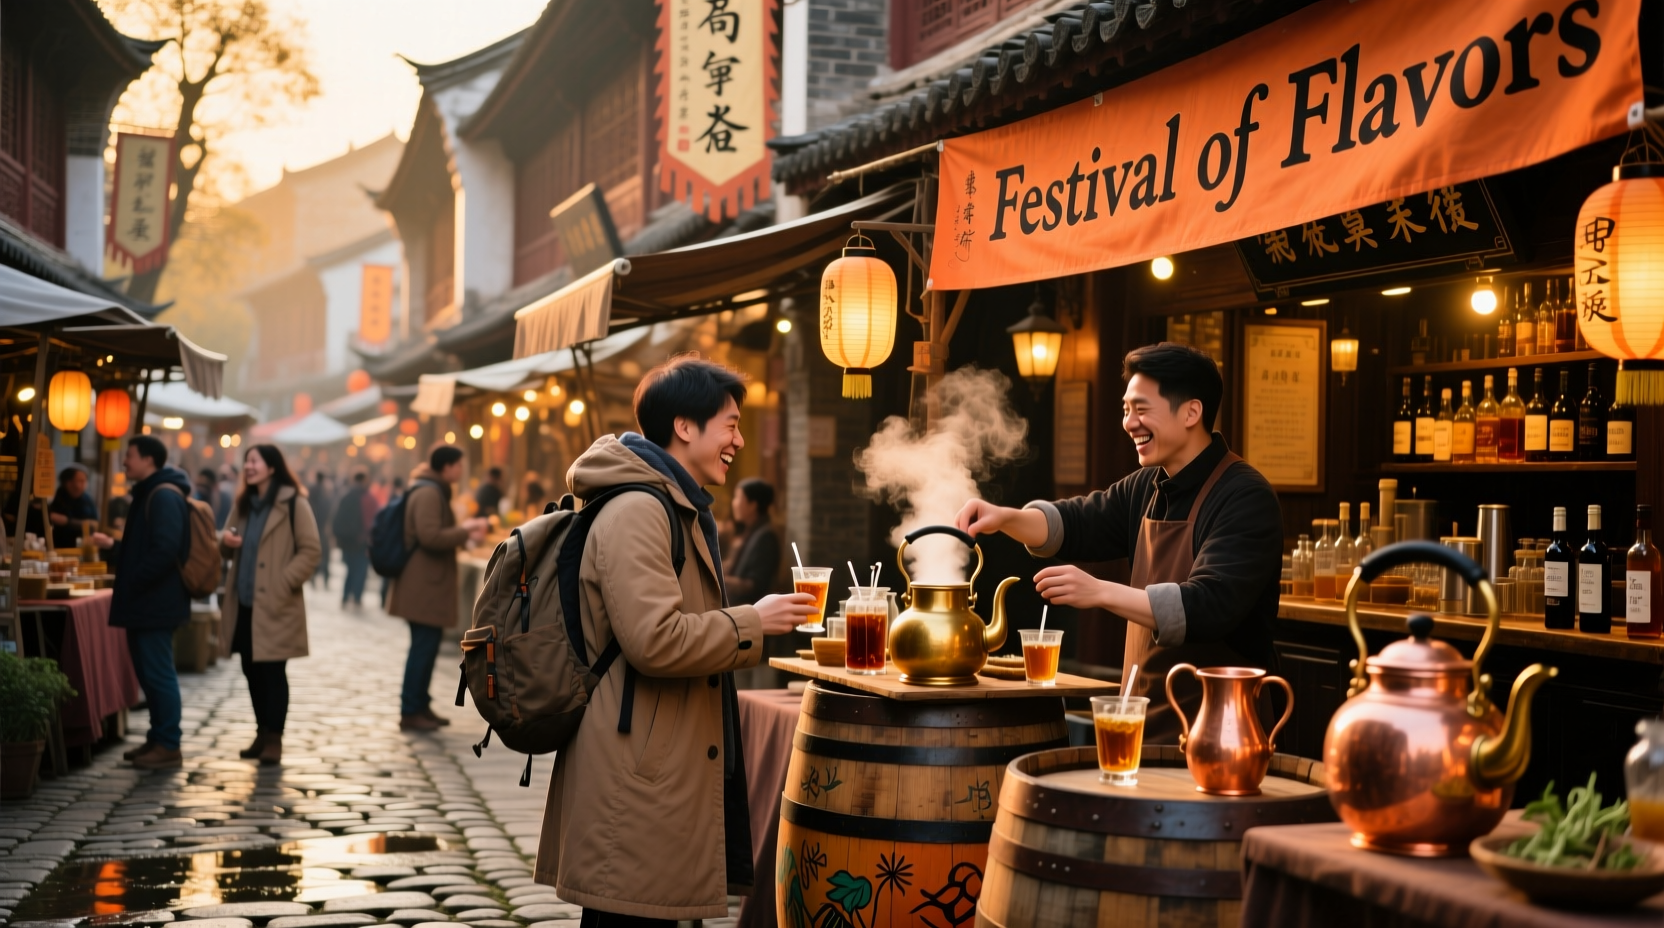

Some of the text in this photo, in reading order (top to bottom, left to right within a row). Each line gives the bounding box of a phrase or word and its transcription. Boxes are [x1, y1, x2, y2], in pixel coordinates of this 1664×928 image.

[990, 115, 1178, 242] Festival
[1197, 83, 1270, 213] of
[1280, 0, 1602, 168] Flavors
